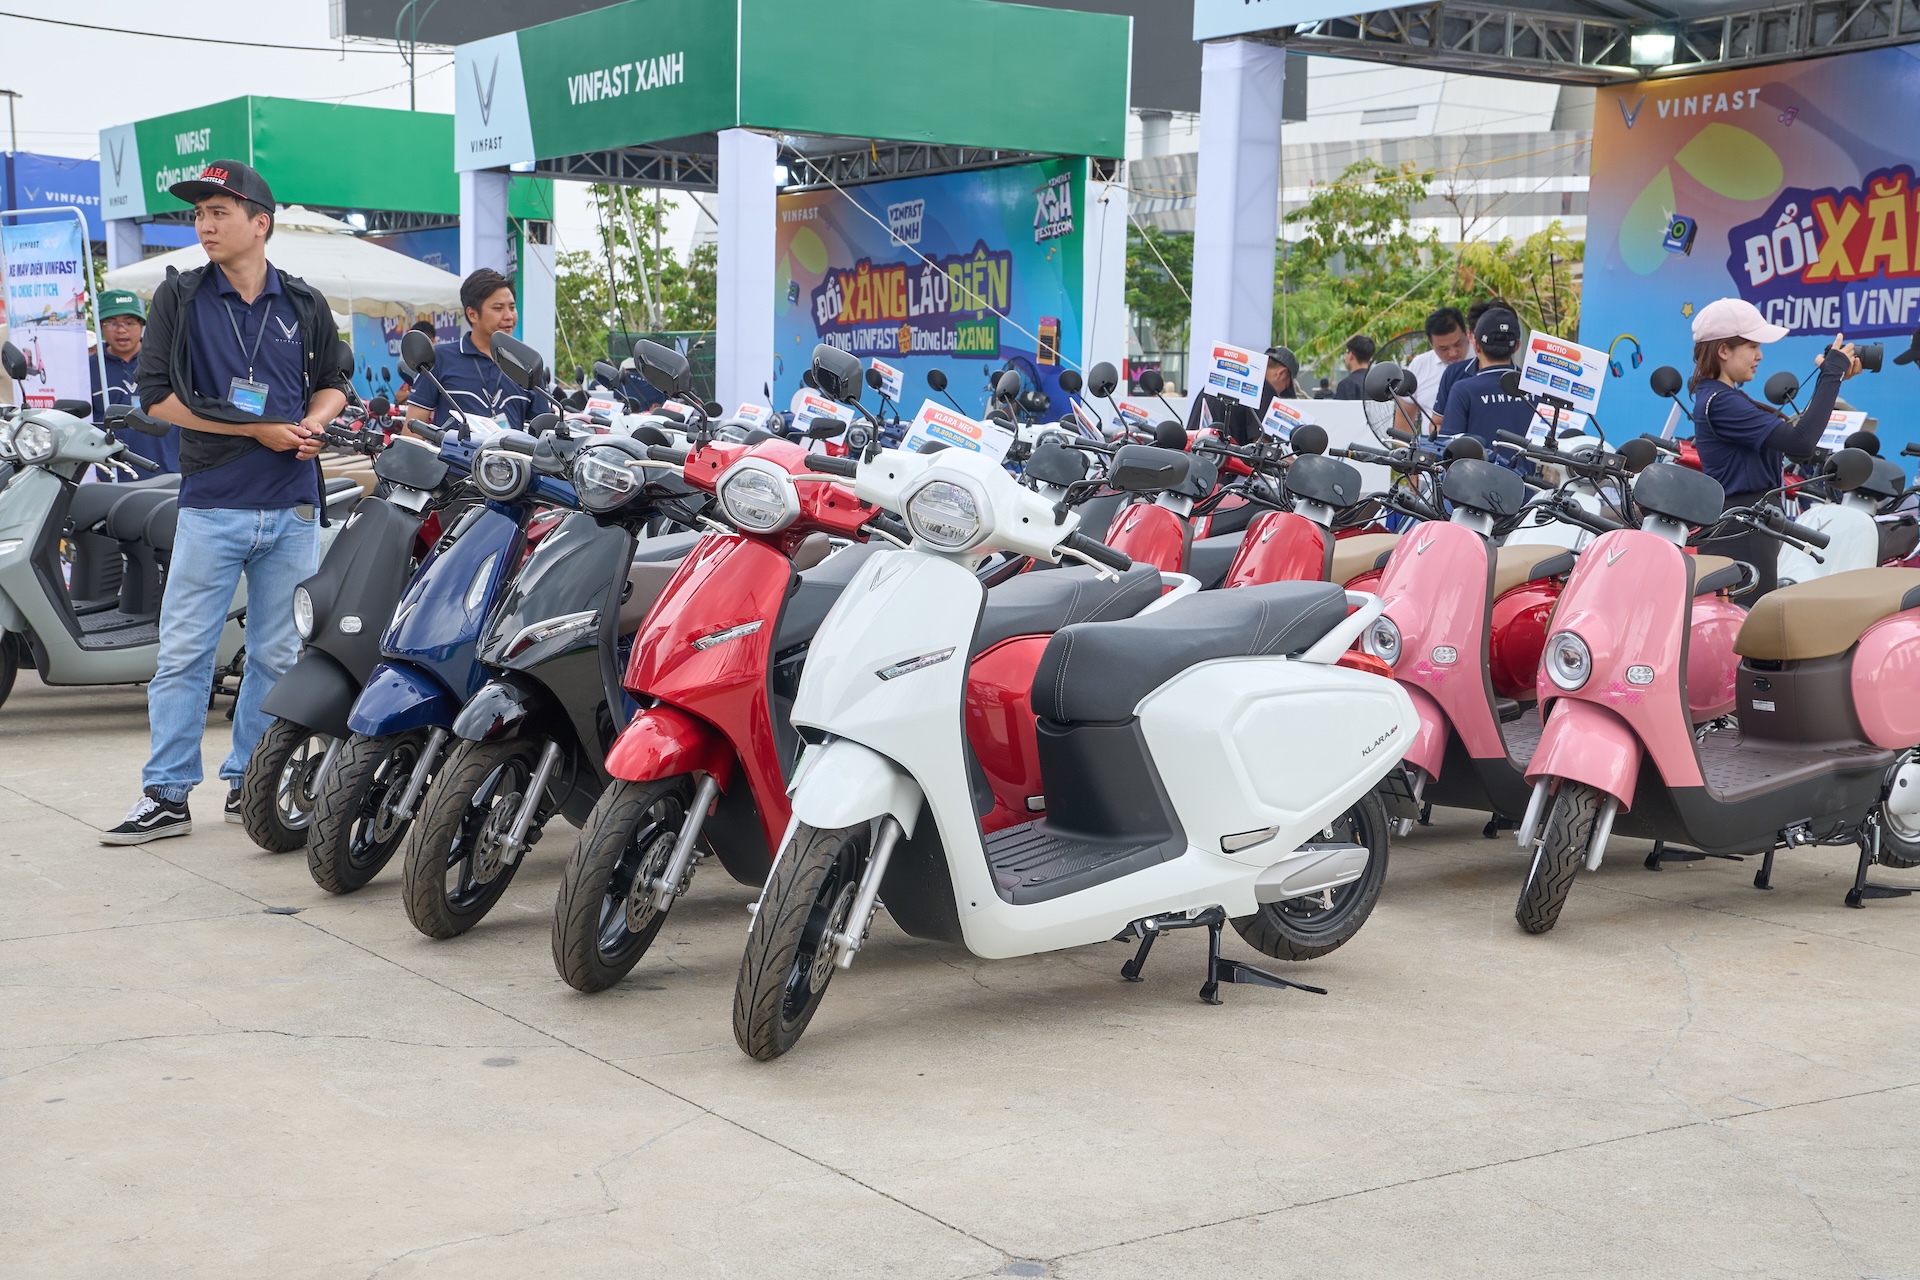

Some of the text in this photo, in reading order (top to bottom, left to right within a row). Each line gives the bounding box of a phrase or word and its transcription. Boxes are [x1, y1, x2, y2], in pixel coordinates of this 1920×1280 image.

[567, 51, 684, 106] VINFAST XANH
[1657, 88, 1761, 119] VINFAST
[175, 128, 211, 155] VINFAST
[471, 136, 503, 153] VINFAST
[45, 191, 100, 206] VINFAST
[109, 195, 128, 206] VINFAST
[782, 207, 819, 223] VINFAST
[889, 203, 923, 222] VINFAST
[892, 221, 920, 242] XANH
[1806, 179, 1920, 279] XĂ
[19, 240, 39, 249] VINFAST
[44, 260, 78, 275] VINFAST
[837, 262, 908, 322] XĂNG
[908, 264, 949, 317] LẤY
[1766, 286, 1920, 329] CÙNG ViNF
[825, 331, 852, 352] CÙNG
[957, 326, 995, 351] XANH
[1546, 343, 1567, 355] MOTIO
[933, 412, 974, 434] KLARA NEO
[965, 440, 978, 449] VND
[1362, 732, 1390, 757] KLARA
